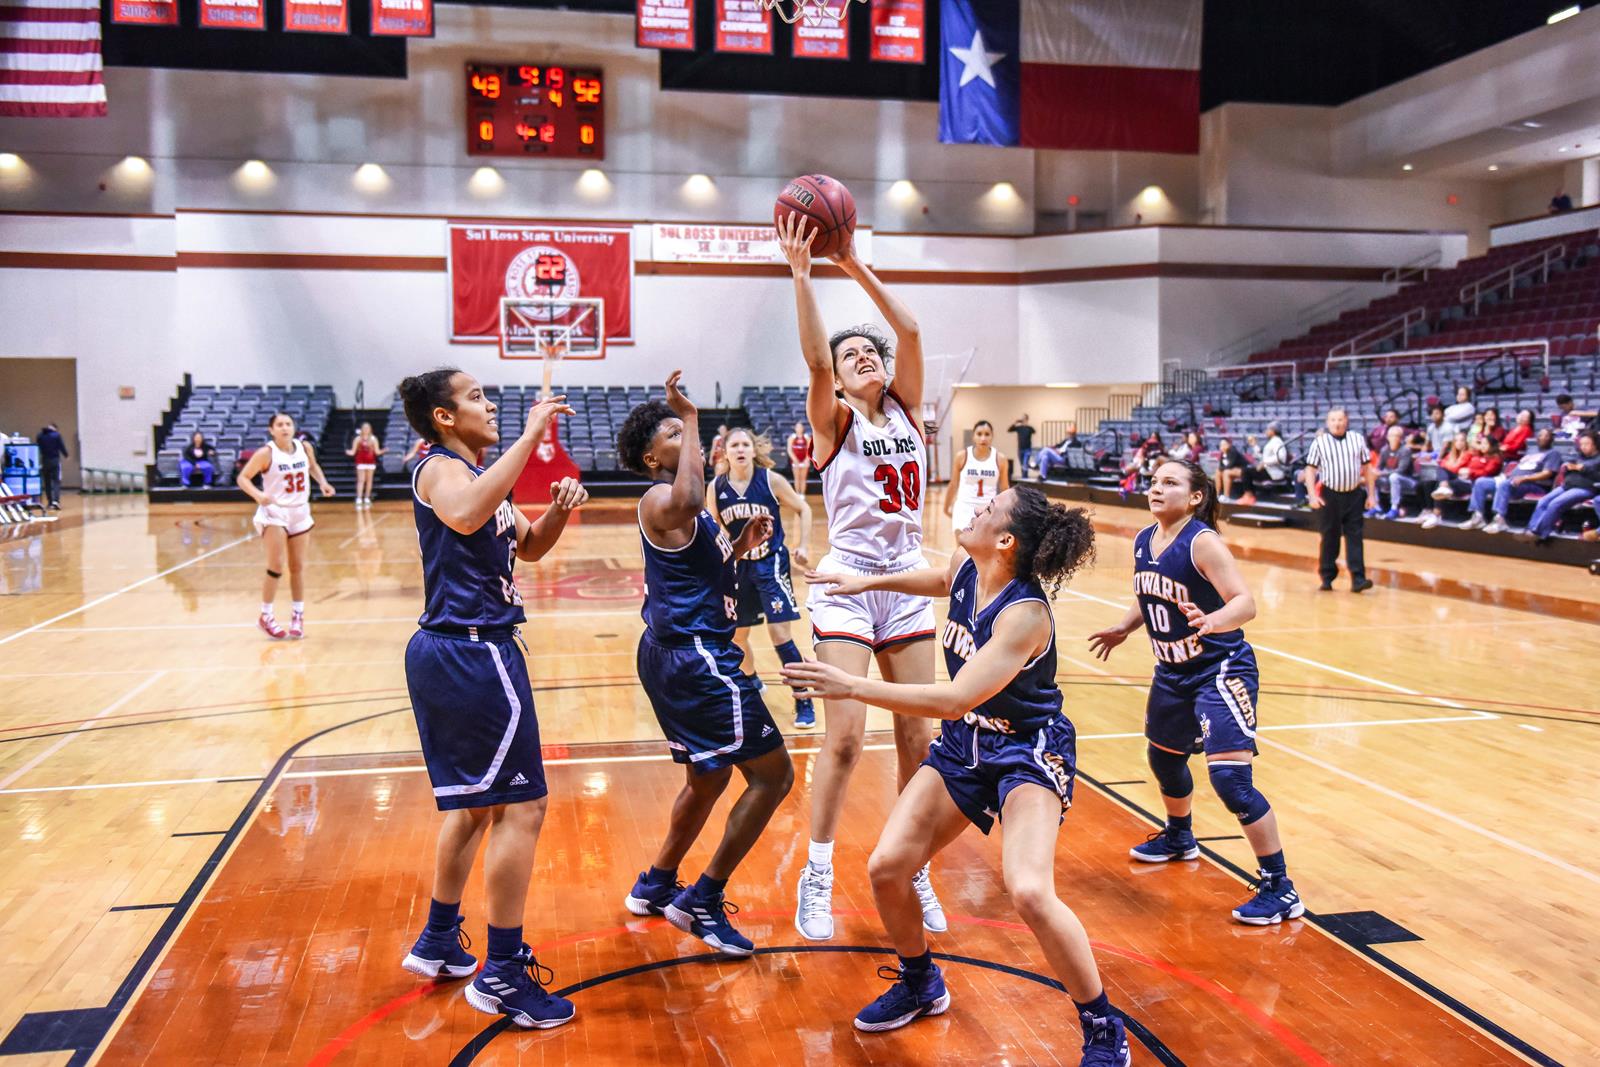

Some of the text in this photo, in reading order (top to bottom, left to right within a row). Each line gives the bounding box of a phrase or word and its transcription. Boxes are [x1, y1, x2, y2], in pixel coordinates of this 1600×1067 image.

[472, 74, 500, 98] 43
[573, 79, 600, 102] 52
[549, 90, 562, 107] 4
[479, 120, 494, 141] 0
[580, 125, 595, 145] 0
[466, 229, 615, 246] Sul Ross State University
[685, 227, 715, 240] ROSS
[537, 255, 566, 279] 22
[862, 439, 891, 456] SUL
[284, 472, 305, 493] 32
[874, 460, 920, 514] 30
[977, 479, 984, 497] 1
[720, 503, 770, 526] HOWARD
[1134, 571, 1189, 604] OWARD
[1147, 603, 1170, 633] 10
[1224, 677, 1256, 727] JACKETS
